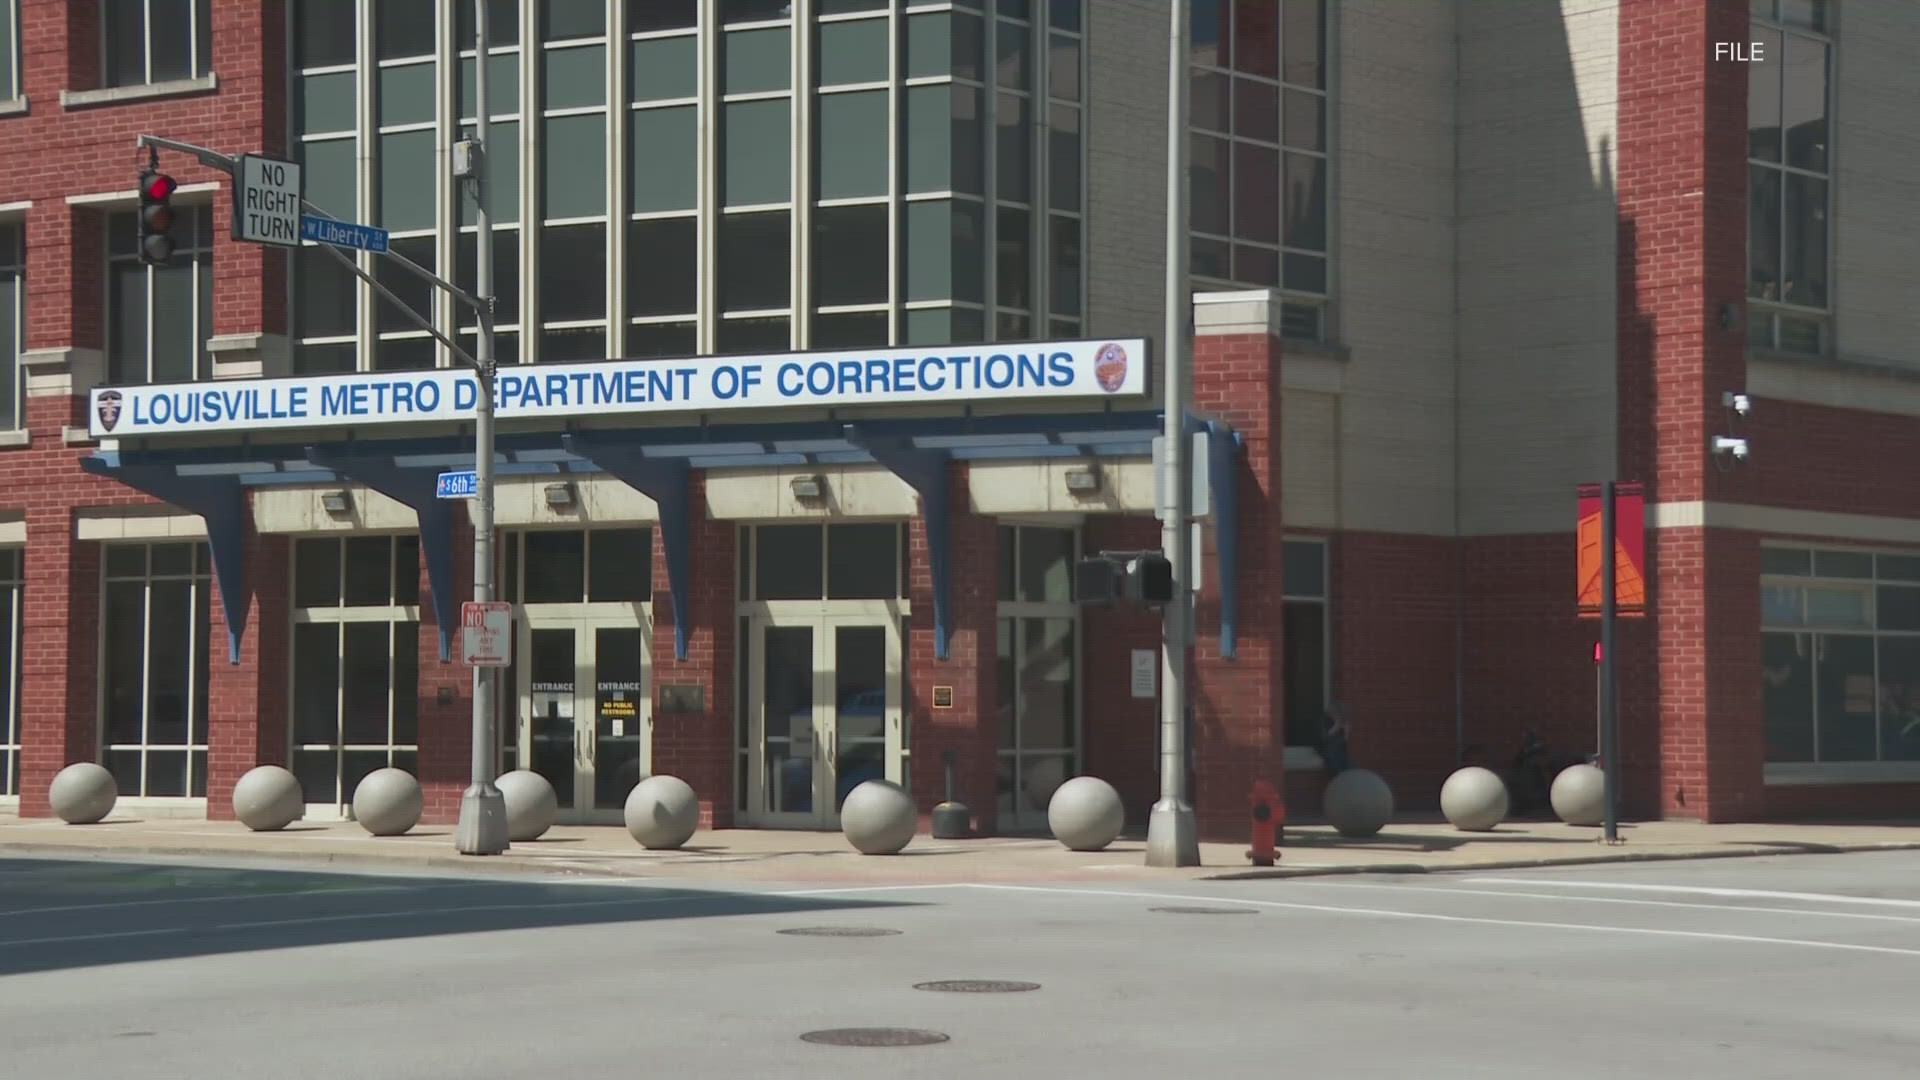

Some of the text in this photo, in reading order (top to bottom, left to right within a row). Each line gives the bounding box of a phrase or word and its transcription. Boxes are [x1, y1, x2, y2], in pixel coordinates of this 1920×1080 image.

[261, 163, 286, 187] NO
[247, 187, 297, 215] RIGHT
[248, 213, 295, 241] TURN
[306, 221, 317, 235] W
[317, 220, 369, 250] Liberty
[132, 351, 1076, 425] LOUISVILLE METRO DPARTMENT OF CORRECTIONS
[445, 478, 452, 491] S
[451, 475, 468, 493] 6th
[467, 611, 483, 626] NO
[532, 682, 574, 691] ENTRANCE
[597, 682, 640, 691] ENTRANCE
